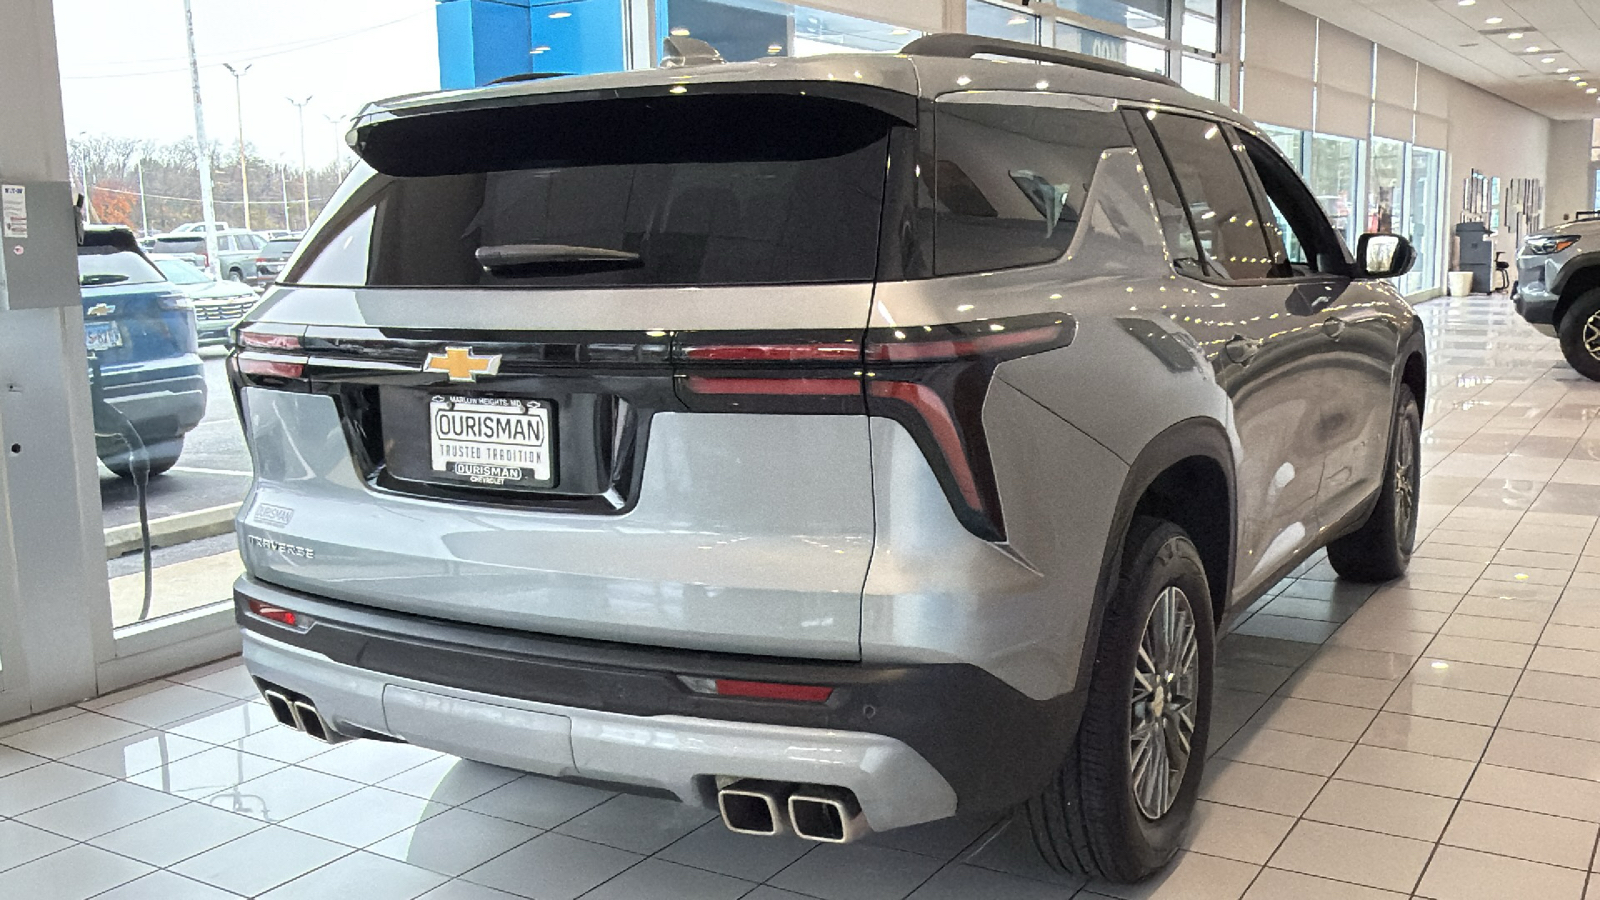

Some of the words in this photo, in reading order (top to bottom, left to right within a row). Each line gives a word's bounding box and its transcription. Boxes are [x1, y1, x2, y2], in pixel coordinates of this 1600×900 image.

[439, 414, 541, 442] OURISMAN
[440, 444, 481, 459] TRUSTED
[487, 447, 542, 464] TRADITION
[457, 464, 519, 478] OURISMAN
[248, 534, 315, 559] TRAVERSE
